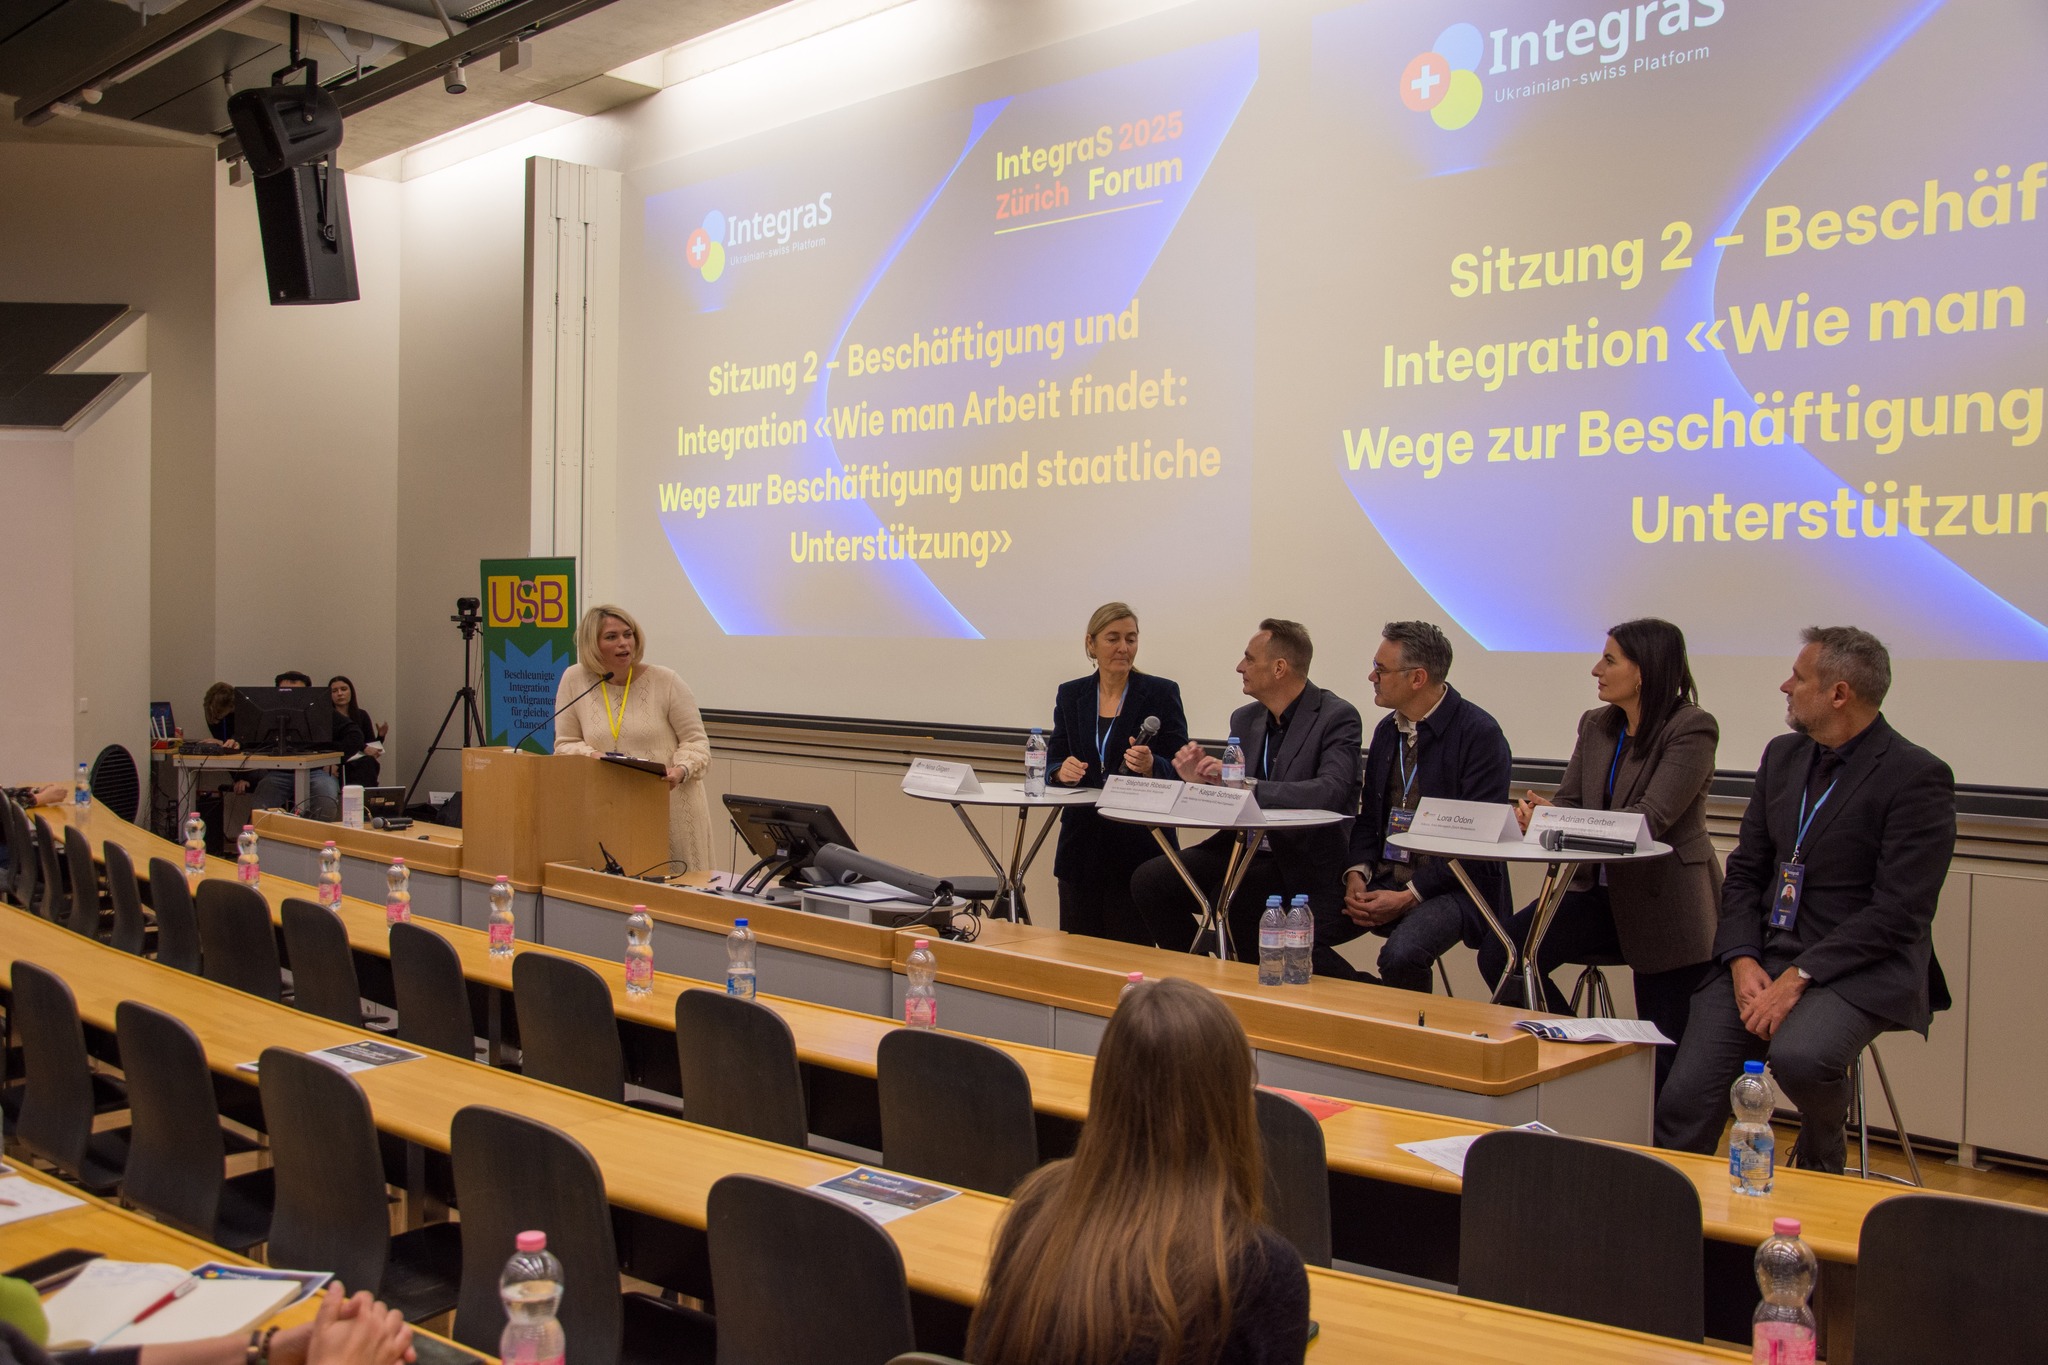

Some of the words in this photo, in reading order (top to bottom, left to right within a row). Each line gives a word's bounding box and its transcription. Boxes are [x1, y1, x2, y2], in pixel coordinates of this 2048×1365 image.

[1495, 64, 1627, 103] Ukrainian-swiss
[1634, 46, 1710, 74] Platform
[996, 125, 1113, 182] IntegraS
[1118, 109, 1184, 152] 2025
[995, 180, 1070, 220] Zürich
[1088, 157, 1183, 201] Forum
[727, 191, 833, 247] IntegraS
[1450, 236, 1644, 298] Sitzung
[1660, 221, 1693, 271] 2
[1765, 161, 2048, 257] Beschäf
[730, 245, 790, 266] Ukrainian-swiss
[792, 237, 826, 252] Platform
[708, 356, 797, 396] Sitzung
[803, 351, 818, 384] 2
[847, 317, 1065, 377] Beschäftigung
[1075, 298, 1140, 346] und
[1384, 317, 1669, 392] Integration
[1686, 293, 1850, 355] «Wie
[1869, 285, 2026, 342] man
[677, 412, 807, 461] Integration
[814, 402, 884, 440] «Wie
[891, 401, 955, 433] man
[962, 380, 1061, 427] Arbeit
[1070, 367, 1188, 417] findet:
[1342, 427, 1474, 479] Wege
[1487, 422, 1566, 464] zur
[1578, 384, 2044, 458] Beschäftigung
[659, 482, 721, 518] Wege
[726, 482, 762, 508] zur
[767, 461, 962, 506] Beschäftigung
[971, 451, 1029, 493] und
[1037, 438, 1221, 487] staatliche
[1631, 480, 2048, 544] Unterstützun
[790, 525, 1012, 568] Unterstützung»
[491, 580, 563, 623] USB
[503, 696, 517, 704] von
[504, 669, 555, 682] Beschleunigte
[509, 682, 550, 694] Integration
[511, 706, 521, 716] für
[522, 707, 550, 719] gleiche
[1436, 814, 1453, 823] Lora
[1453, 815, 1475, 825] Odoni
[1558, 814, 1586, 824] Adrian
[1586, 816, 1616, 827] Gerber
